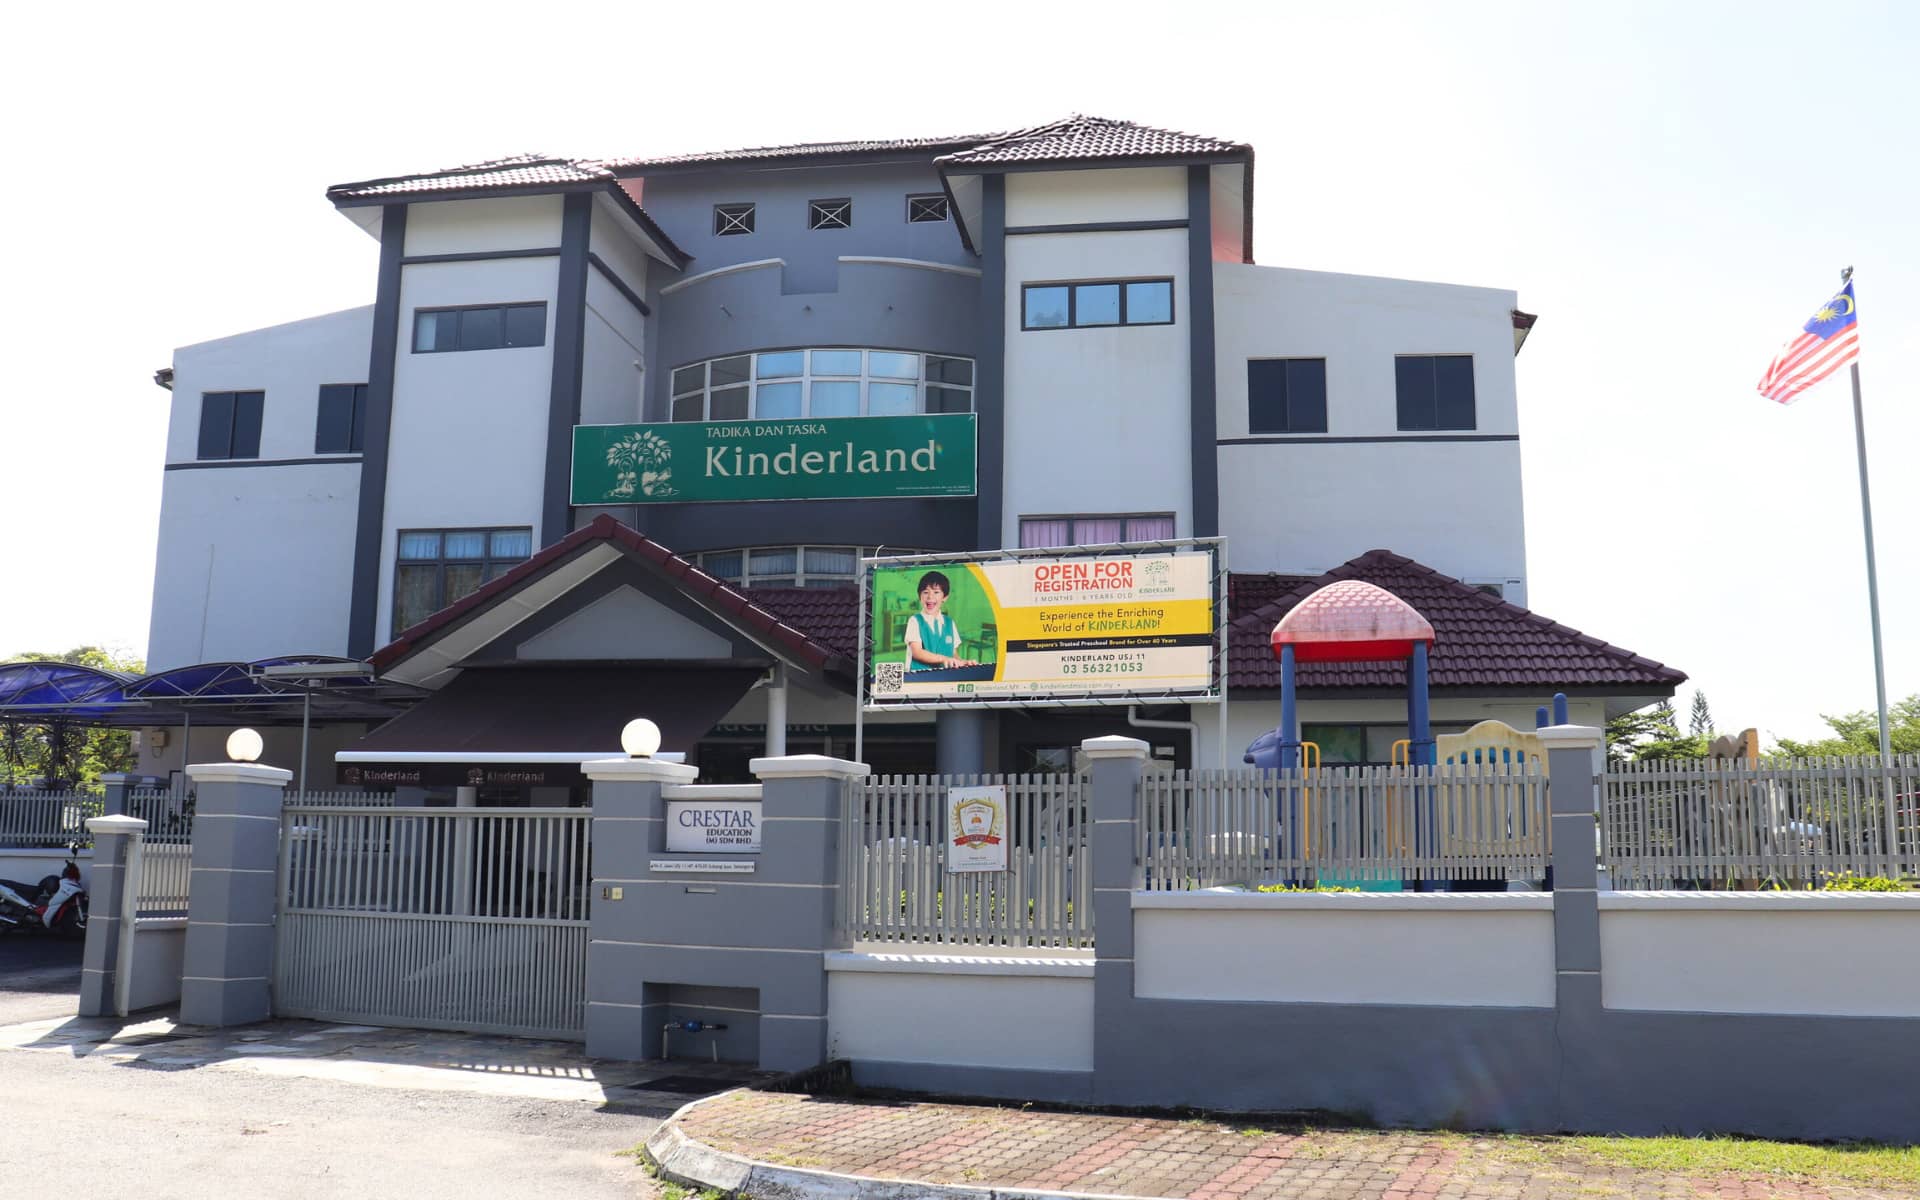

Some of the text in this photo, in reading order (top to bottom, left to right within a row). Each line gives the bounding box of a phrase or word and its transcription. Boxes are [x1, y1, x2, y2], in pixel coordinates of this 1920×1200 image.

[706, 424, 827, 438] TADIKA DAN TASKA
[705, 440, 937, 477] Kinderland
[1034, 562, 1133, 580] OPEN FOR
[1034, 577, 1133, 592] REGISTRATION
[1040, 608, 1164, 622] Experience the Enriching
[1042, 619, 1160, 632] World of KINDERLAND!
[1063, 662, 1143, 674] 03 56321053
[364, 770, 420, 782] Kinderland
[680, 810, 755, 827] CRESTAR
[706, 828, 752, 836] EDUCATION
